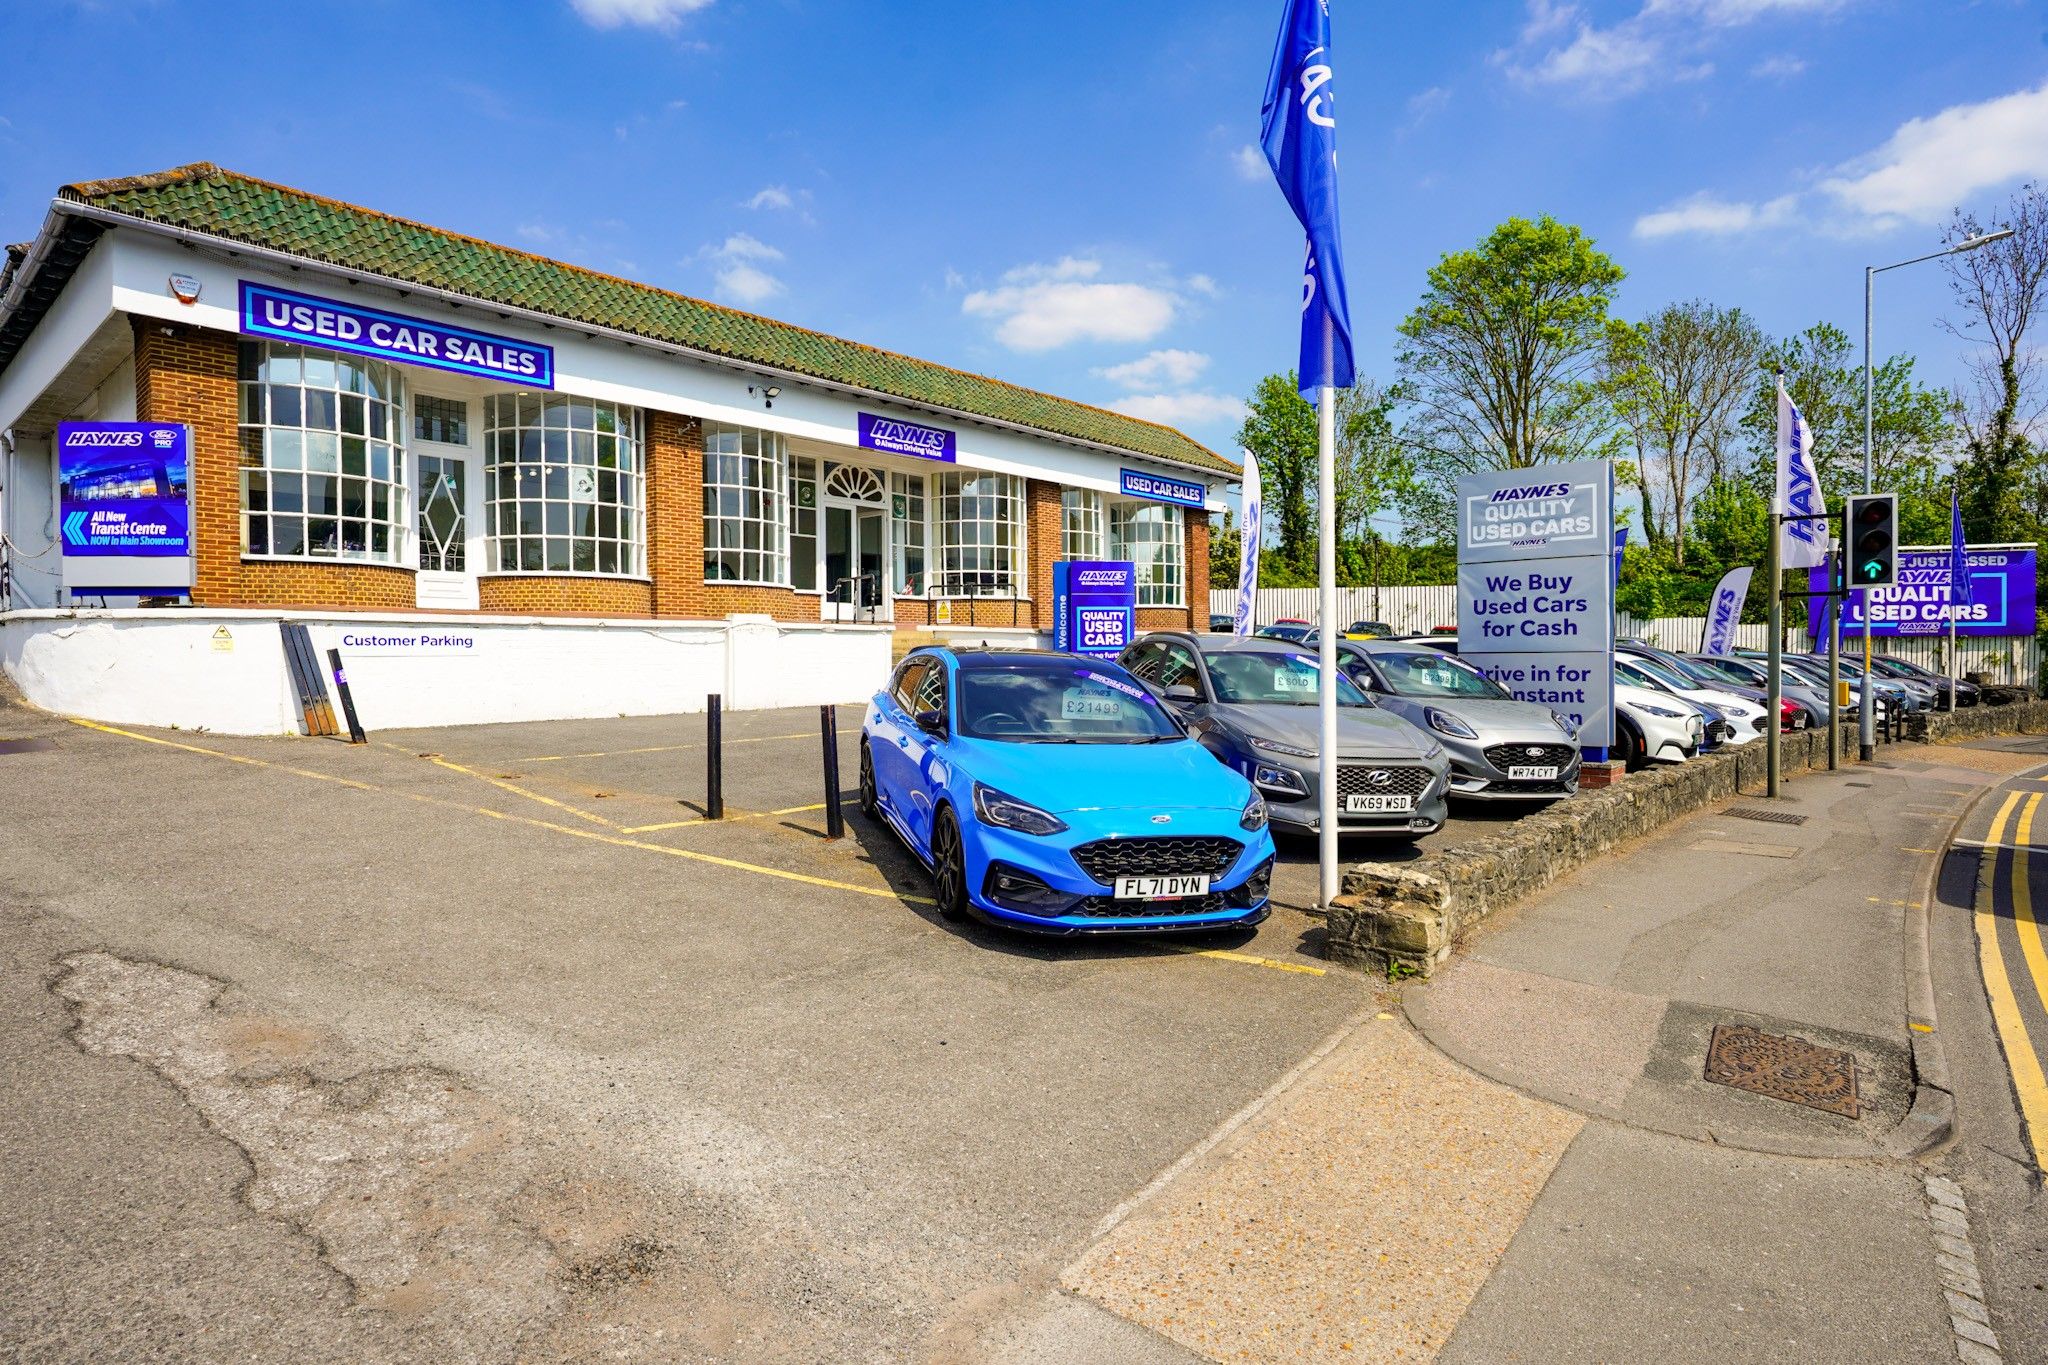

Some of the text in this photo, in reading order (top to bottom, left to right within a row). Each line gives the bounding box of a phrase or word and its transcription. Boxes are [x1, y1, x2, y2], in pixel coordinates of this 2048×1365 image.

[265, 299, 536, 375] USED CAR SALES
[66, 431, 143, 446] HAYNES
[870, 419, 945, 450] HAYNES
[881, 439, 942, 457] Always Driving Value
[1788, 405, 1814, 546] HAYN
[1126, 475, 1200, 502] USED CAR SALES
[1490, 482, 1570, 503] HAYNES
[91, 511, 126, 522] All New
[1485, 498, 1576, 523] QUALITY
[90, 522, 167, 535] Transit Centre
[1472, 516, 1591, 541] USED CARS
[90, 536, 110, 545] NOW
[120, 536, 140, 545] Main
[141, 536, 184, 545] Showroom
[1512, 538, 1547, 546] HAYNES
[1908, 556, 1946, 568] JUST
[1078, 570, 1127, 580] HAYNES
[1898, 569, 1952, 585] AYNE
[1486, 574, 1573, 594] We Buy
[1870, 586, 1952, 604] QUALIT
[1473, 596, 1588, 615] Used Cars
[1852, 604, 1917, 621] USED
[1921, 603, 1988, 620] CARS
[1059, 594, 1067, 648] Welcome
[1082, 611, 1125, 621] QUALITY
[1084, 621, 1123, 633] USED
[1482, 618, 1578, 637] for Cash
[1898, 622, 1941, 630] HAYNES
[343, 635, 473, 648] Customer Parking
[1084, 633, 1124, 646] CARS
[1531, 665, 1550, 681] in
[1556, 665, 1591, 681] for
[1286, 678, 1308, 686] SOLD
[1509, 687, 1585, 703] nstant
[1066, 700, 1120, 713] £21499
[1512, 768, 1555, 778] WR74 CYT
[1353, 797, 1407, 808] VK69 WSD
[1125, 877, 1201, 895] FL71 DYN
